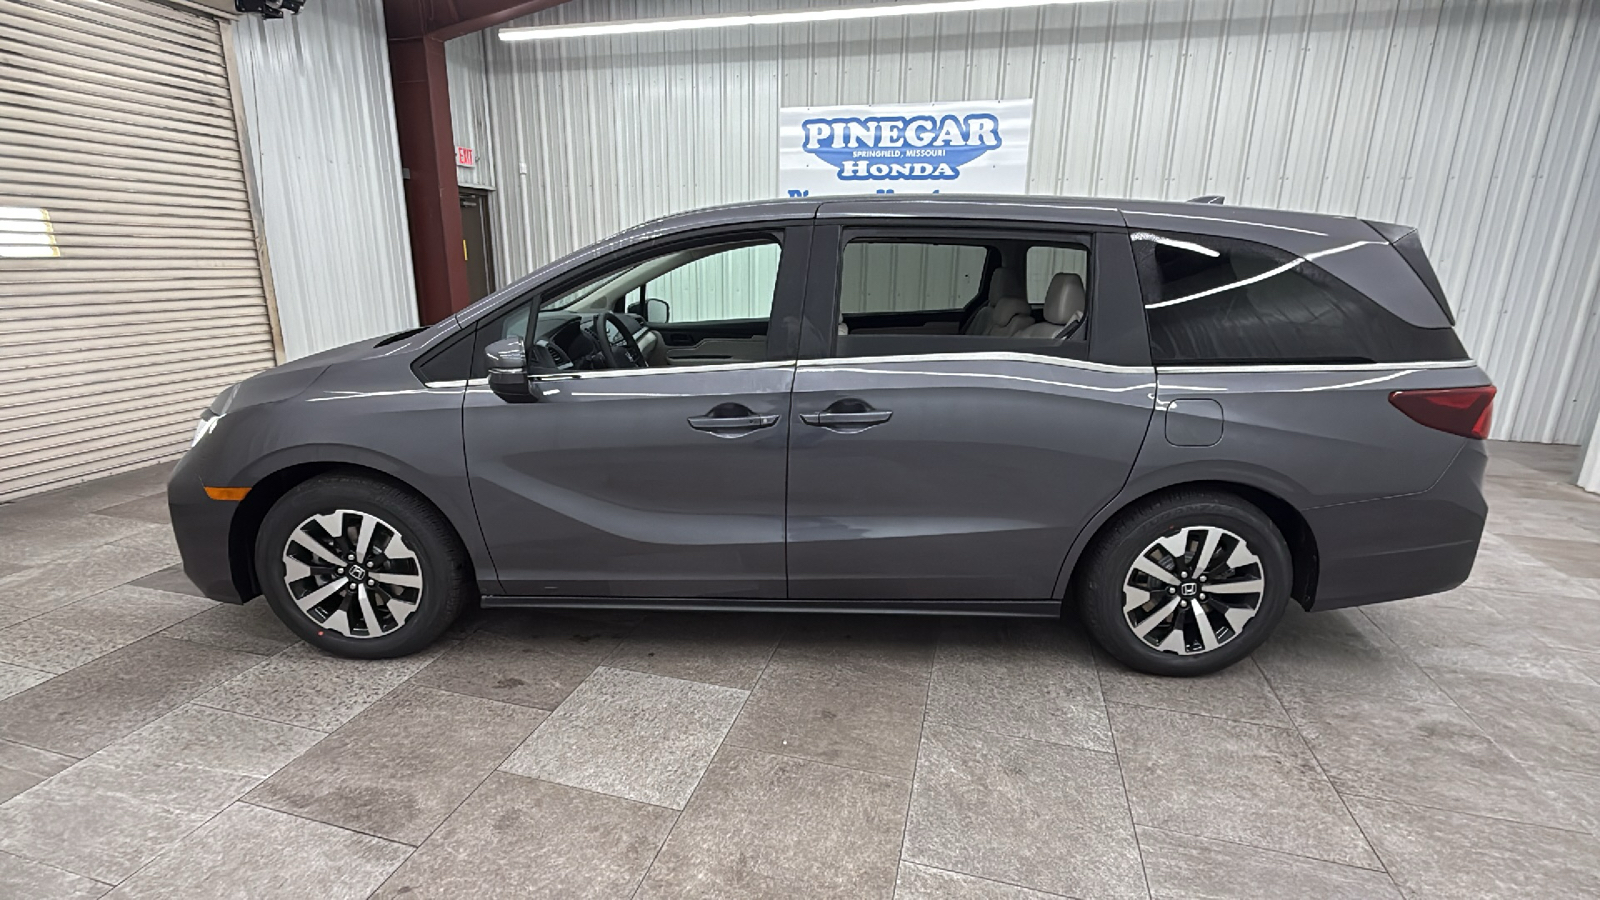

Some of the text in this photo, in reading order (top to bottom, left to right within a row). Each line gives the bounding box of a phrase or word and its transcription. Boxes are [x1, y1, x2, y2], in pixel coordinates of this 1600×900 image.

[806, 117, 999, 149] PINEGAR
[458, 147, 473, 165] EXIT
[852, 149, 946, 159] SPRINGFIELD, MISSOURI
[841, 160, 955, 177] HONDA
